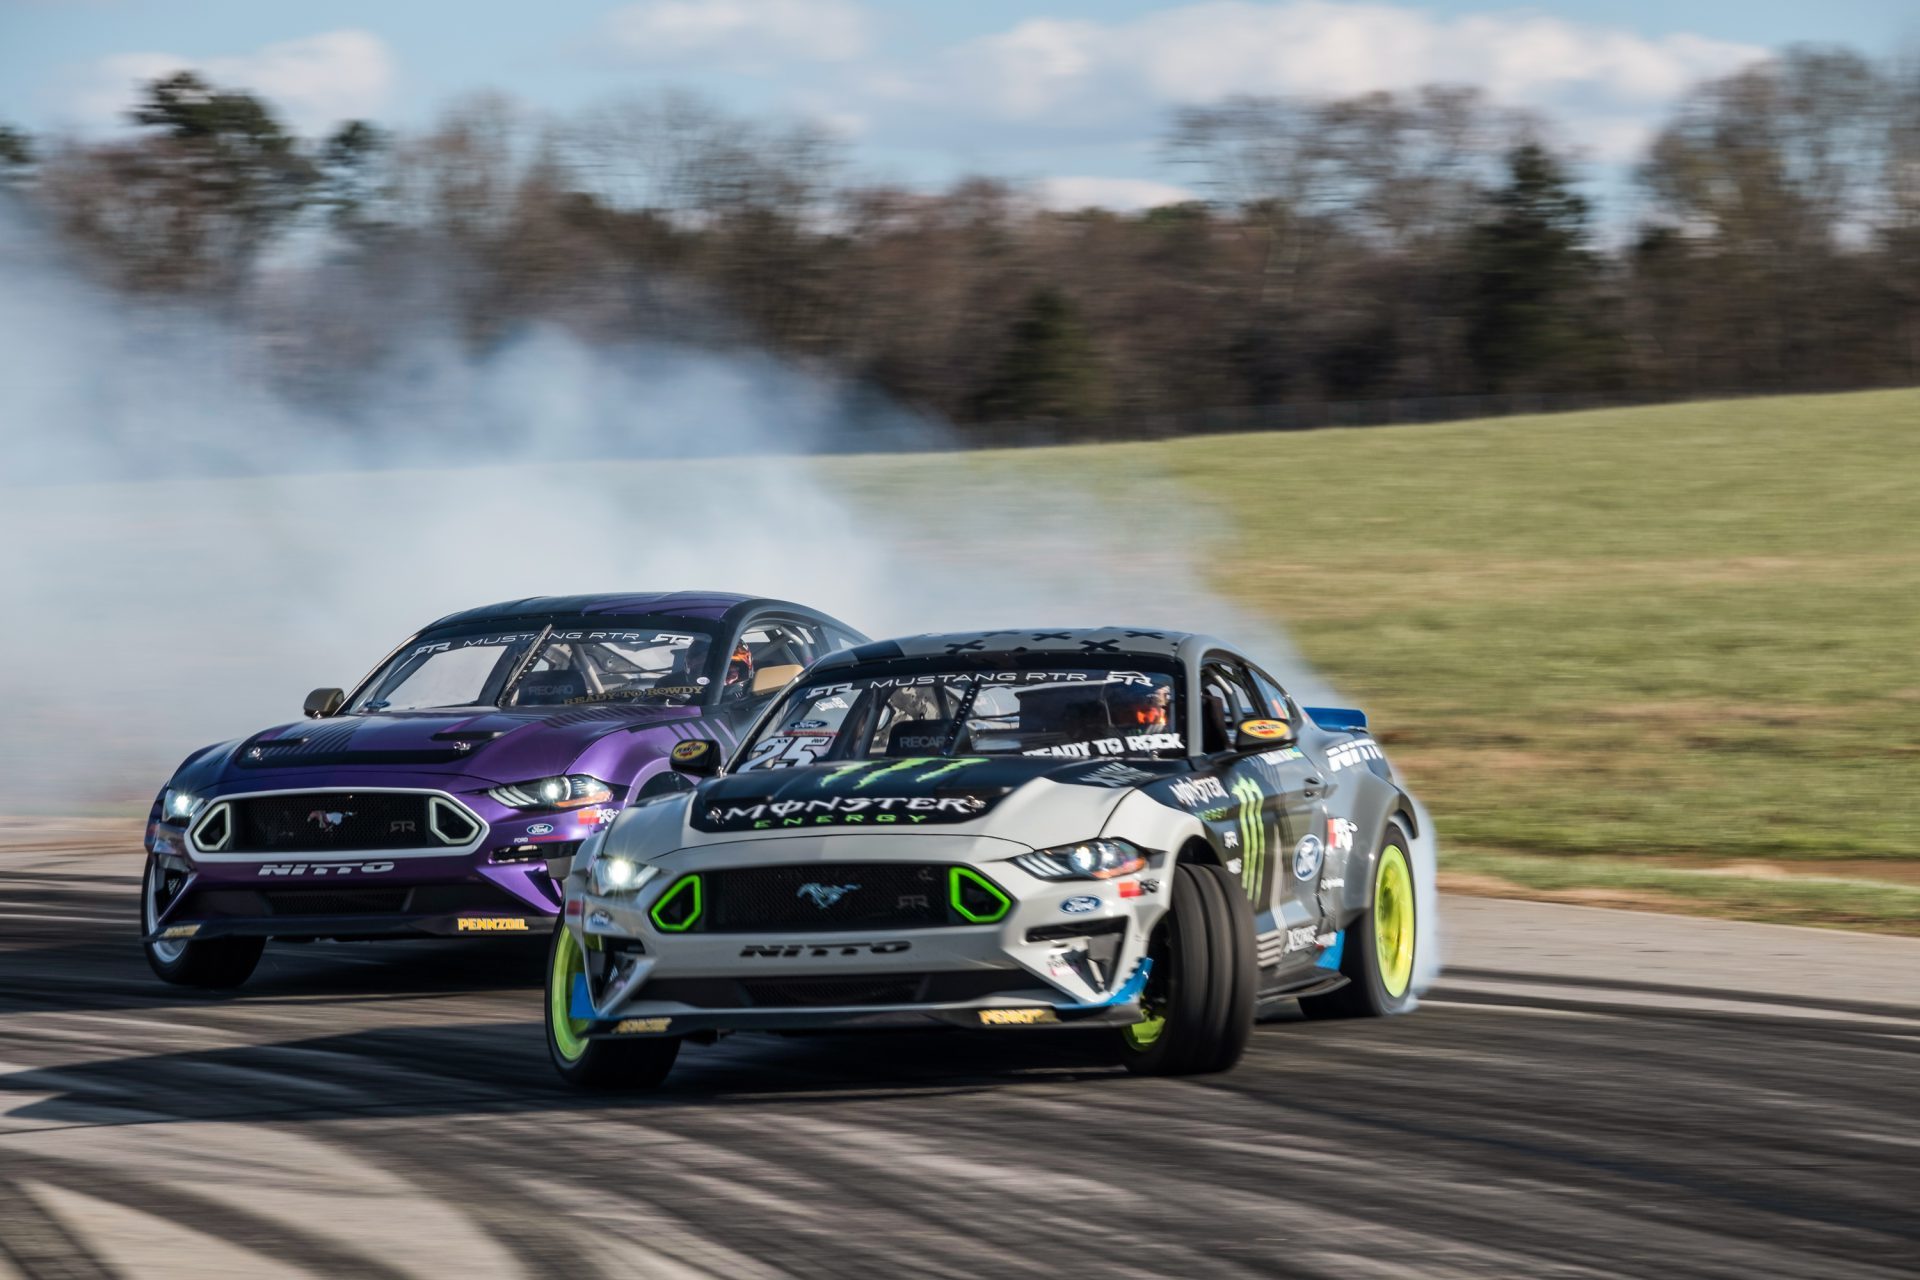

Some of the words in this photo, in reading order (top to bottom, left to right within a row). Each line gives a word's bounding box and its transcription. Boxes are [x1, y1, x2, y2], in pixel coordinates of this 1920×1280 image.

[588, 632, 640, 641] RTR
[870, 672, 1016, 689] MUSTANG
[1025, 672, 1088, 681] RTR
[623, 689, 642, 698] TO
[647, 685, 704, 697] ROWDY
[900, 735, 946, 748] RECAR
[1095, 738, 1123, 755] TO
[1125, 733, 1185, 752] ROCK
[754, 813, 927, 829] ENERGY
[258, 861, 395, 876] NITTO
[457, 917, 529, 931] PENNZOIL
[738, 941, 913, 958] NITTO
